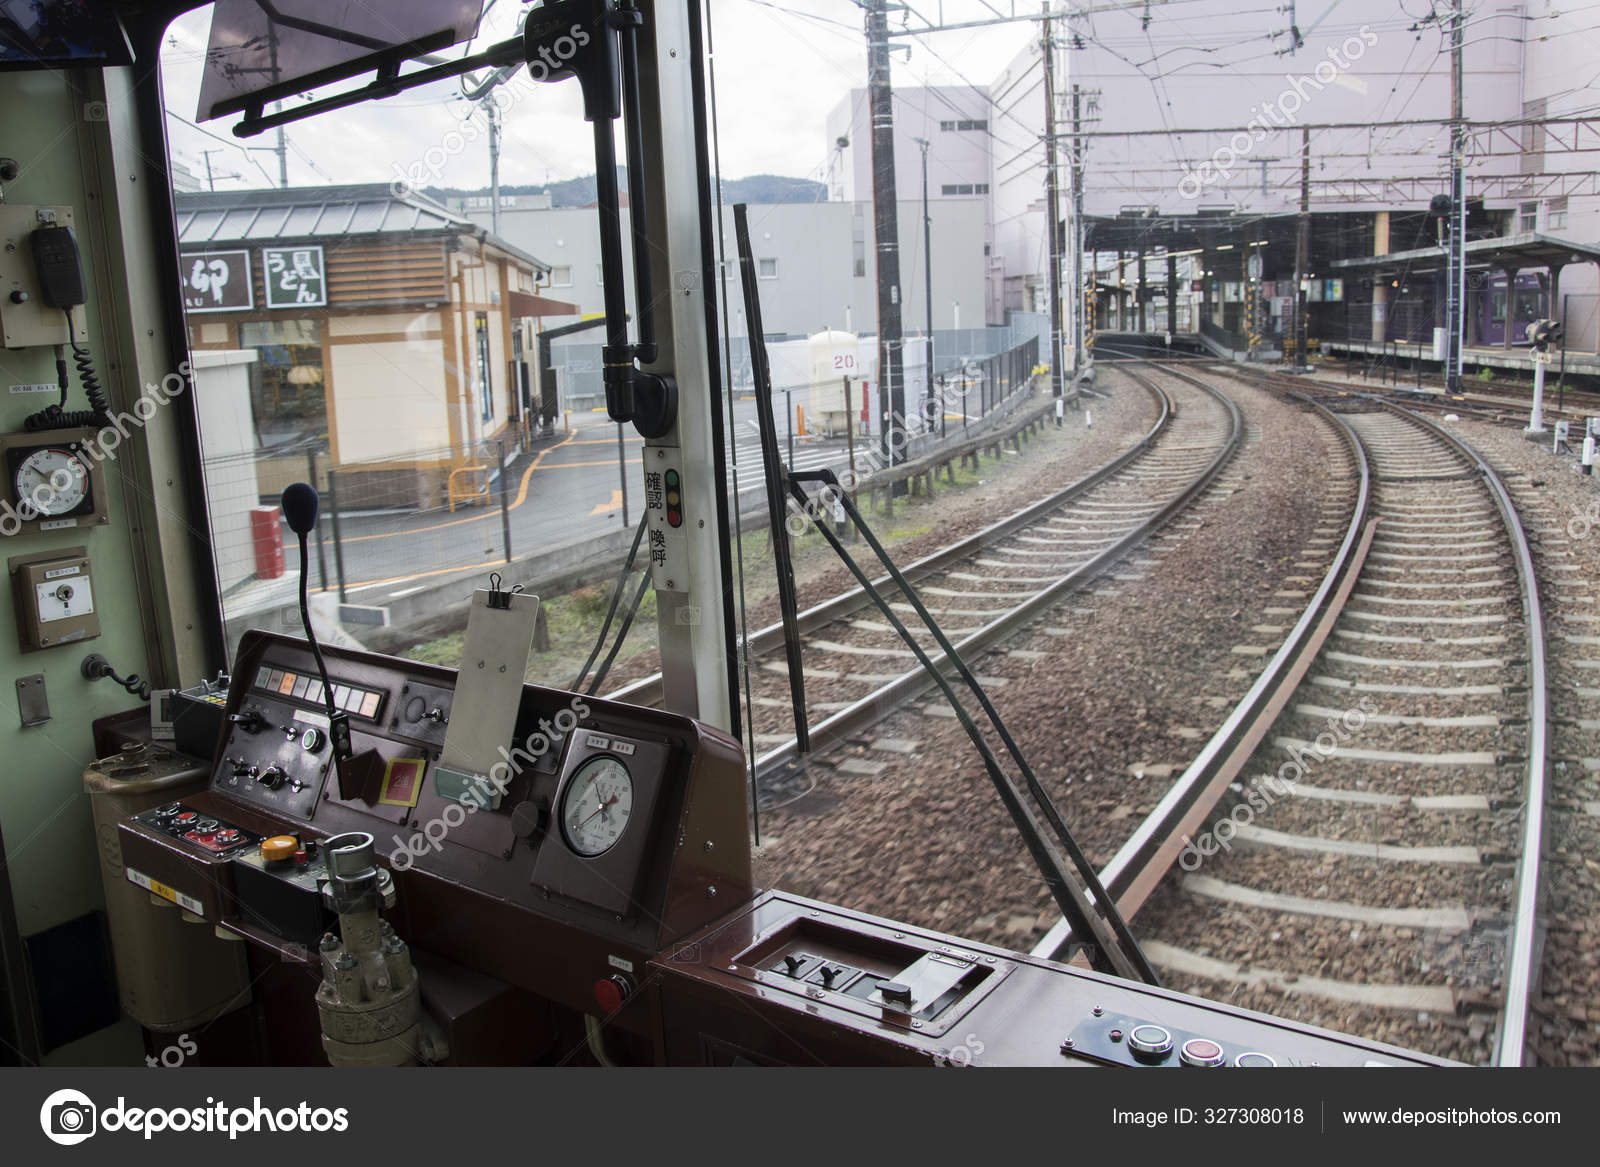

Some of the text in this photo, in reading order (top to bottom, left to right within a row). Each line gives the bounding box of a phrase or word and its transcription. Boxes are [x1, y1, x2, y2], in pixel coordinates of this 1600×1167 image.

[183, 259, 229, 304] 卯
[268, 252, 317, 303] うどん
[834, 355, 854, 369] 20
[646, 472, 667, 567] 確認・喚呼
